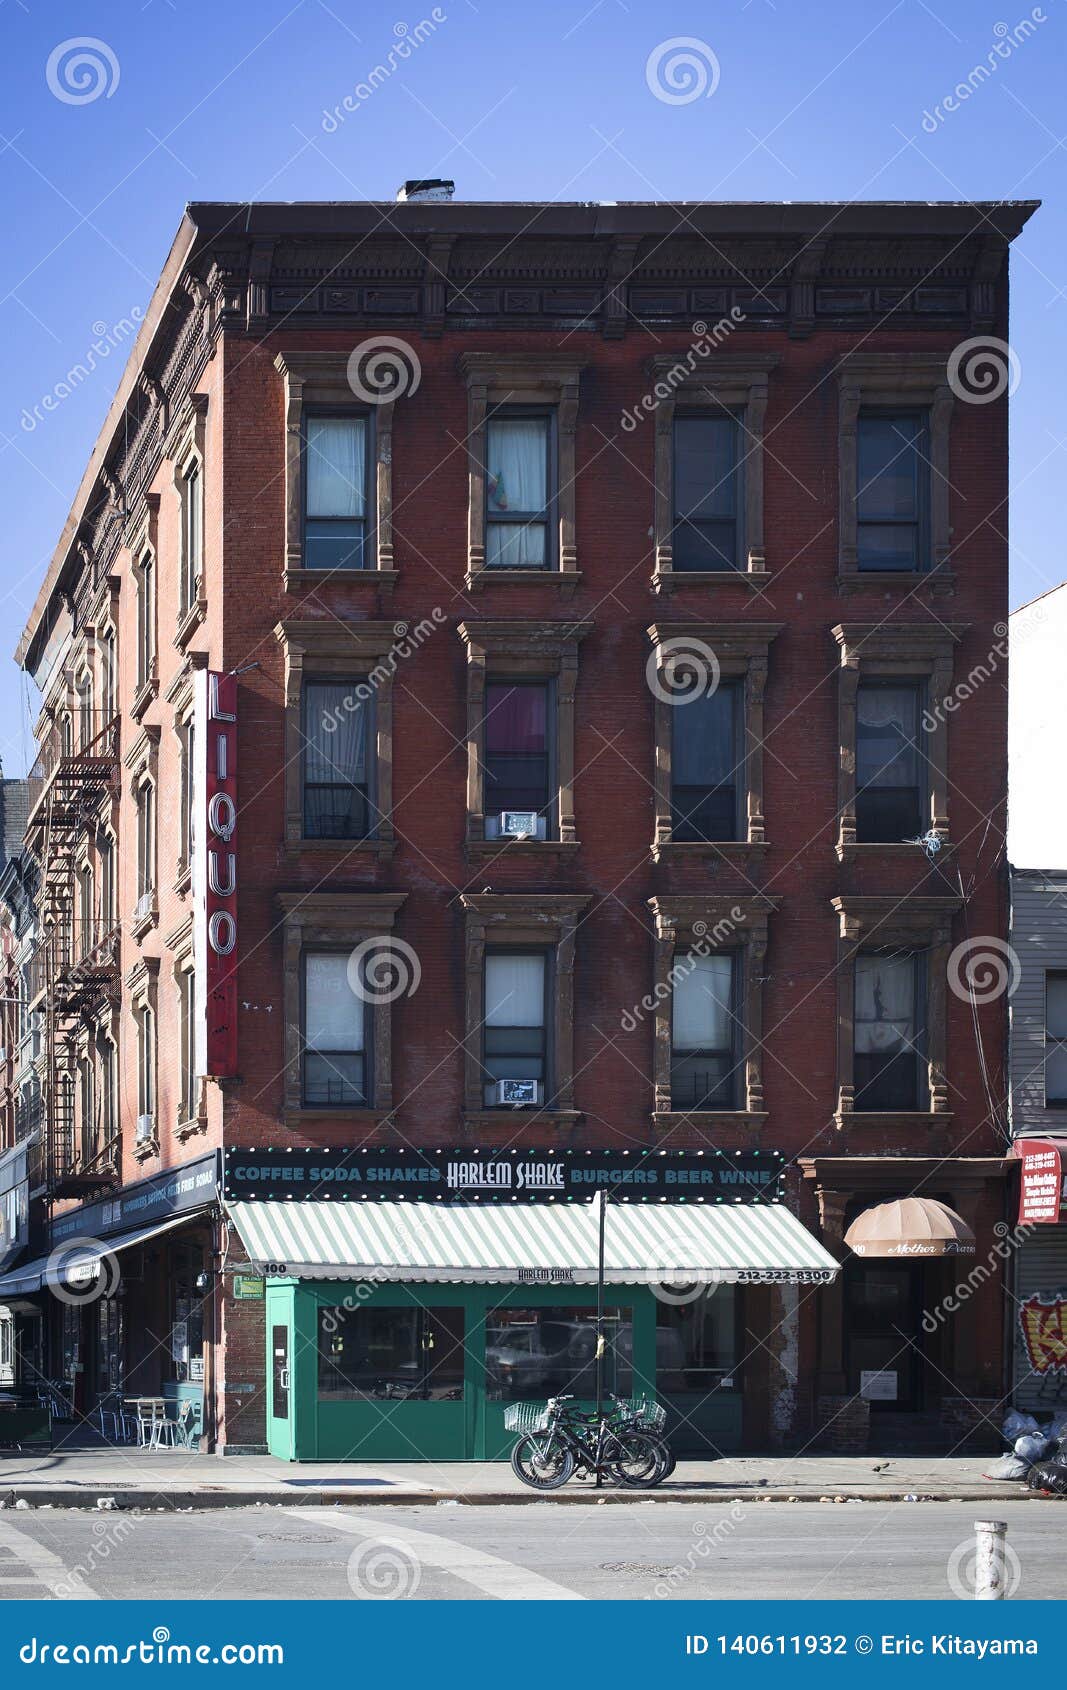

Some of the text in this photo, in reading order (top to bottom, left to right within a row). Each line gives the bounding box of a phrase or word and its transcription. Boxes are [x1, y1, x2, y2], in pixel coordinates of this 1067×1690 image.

[208, 673, 237, 954] LIQUO
[234, 1162, 771, 1189] COFFEE SODA SHAKES HARLEM SHAKE BURGERS BEER WINE
[888, 1243, 937, 1254] Mother
[264, 1264, 287, 1273] 100
[518, 1269, 574, 1281] HARLEM SHAKE
[738, 1271, 830, 1280] 212-222-8300
